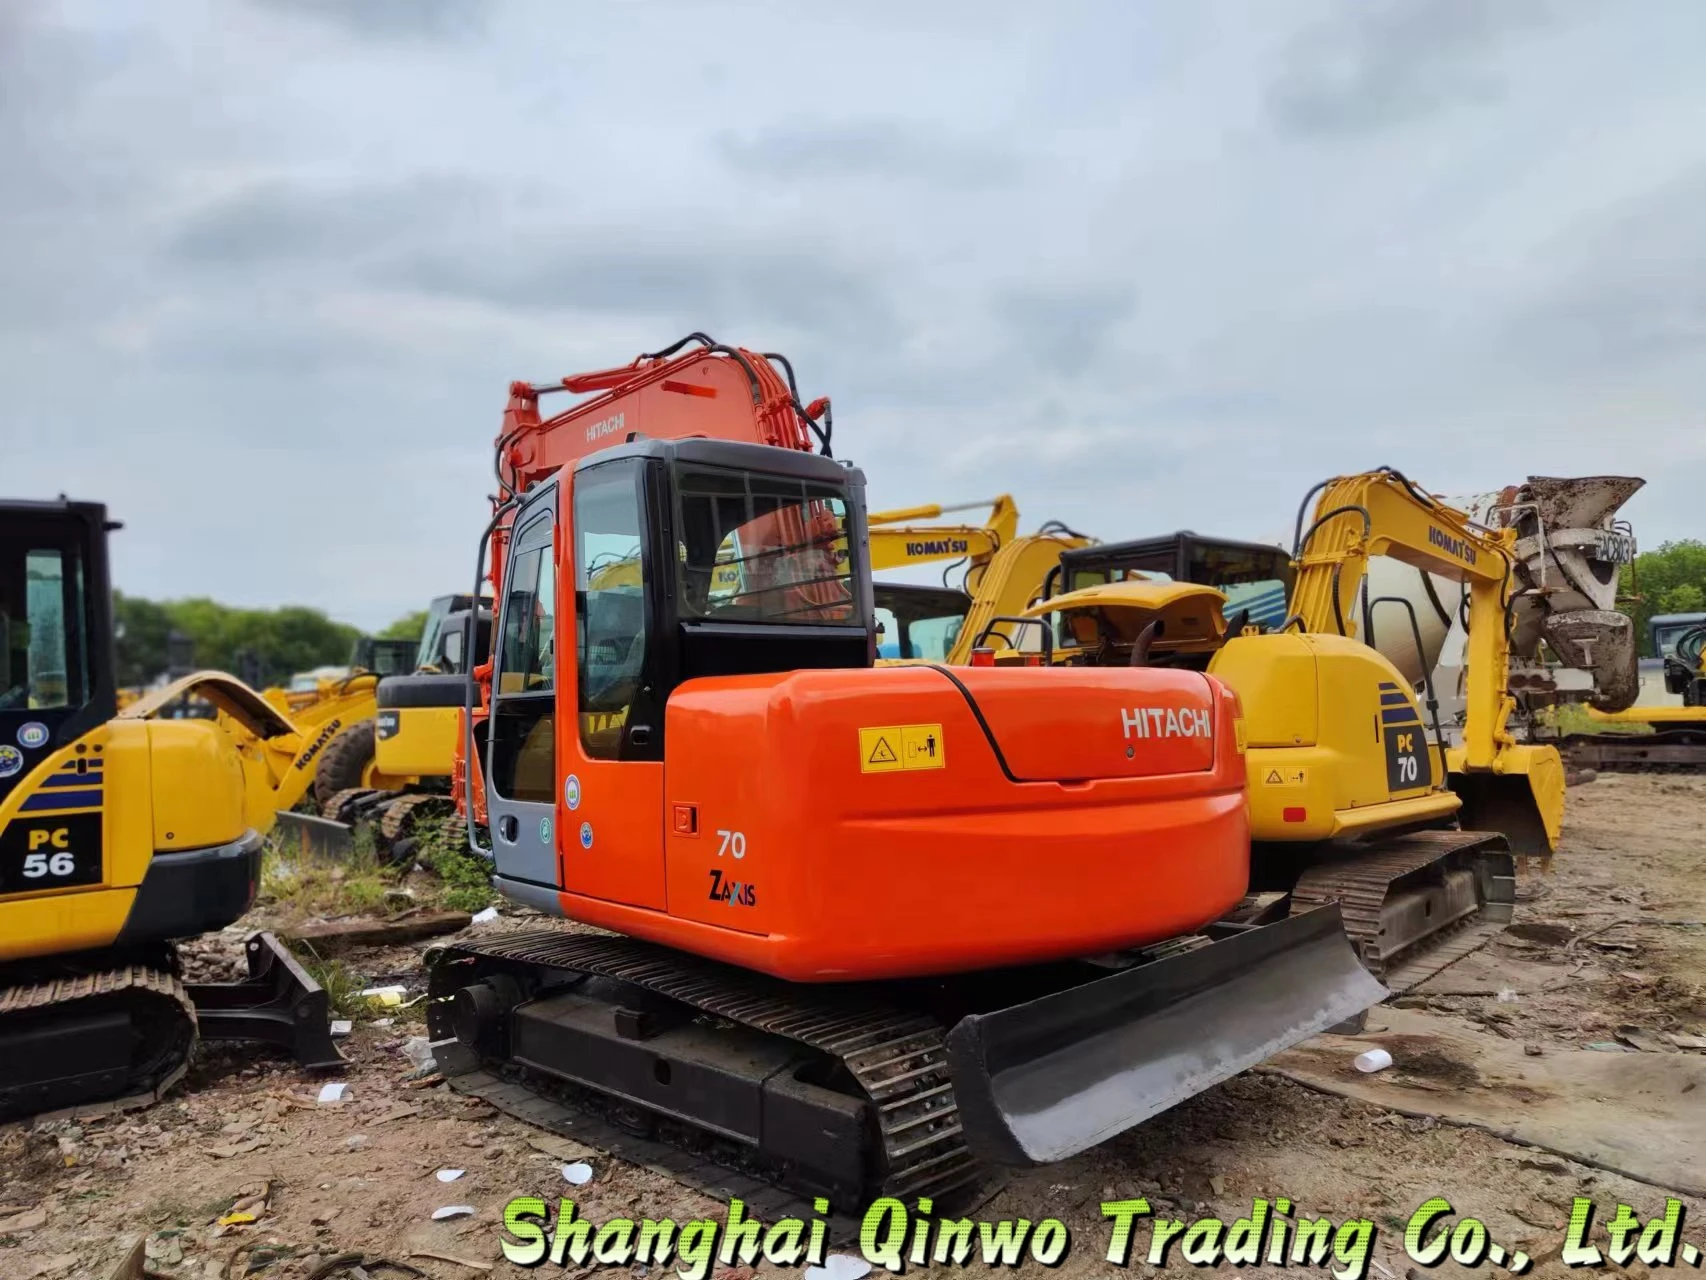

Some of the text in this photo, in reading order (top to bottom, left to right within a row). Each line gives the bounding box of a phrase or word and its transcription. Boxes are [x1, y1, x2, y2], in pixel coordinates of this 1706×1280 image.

[586, 412, 625, 442] HITACHI
[906, 537, 967, 556] KOMATSU
[1429, 525, 1476, 565] KOMATSU
[1121, 707, 1211, 738] HITACHI
[295, 719, 341, 770] KOMATSU
[1397, 733, 1413, 753] PC
[1398, 755, 1417, 783] 70
[28, 828, 69, 850] PC
[717, 829, 746, 859] 70
[22, 852, 75, 878] 56
[708, 868, 757, 908] ZAXIS
